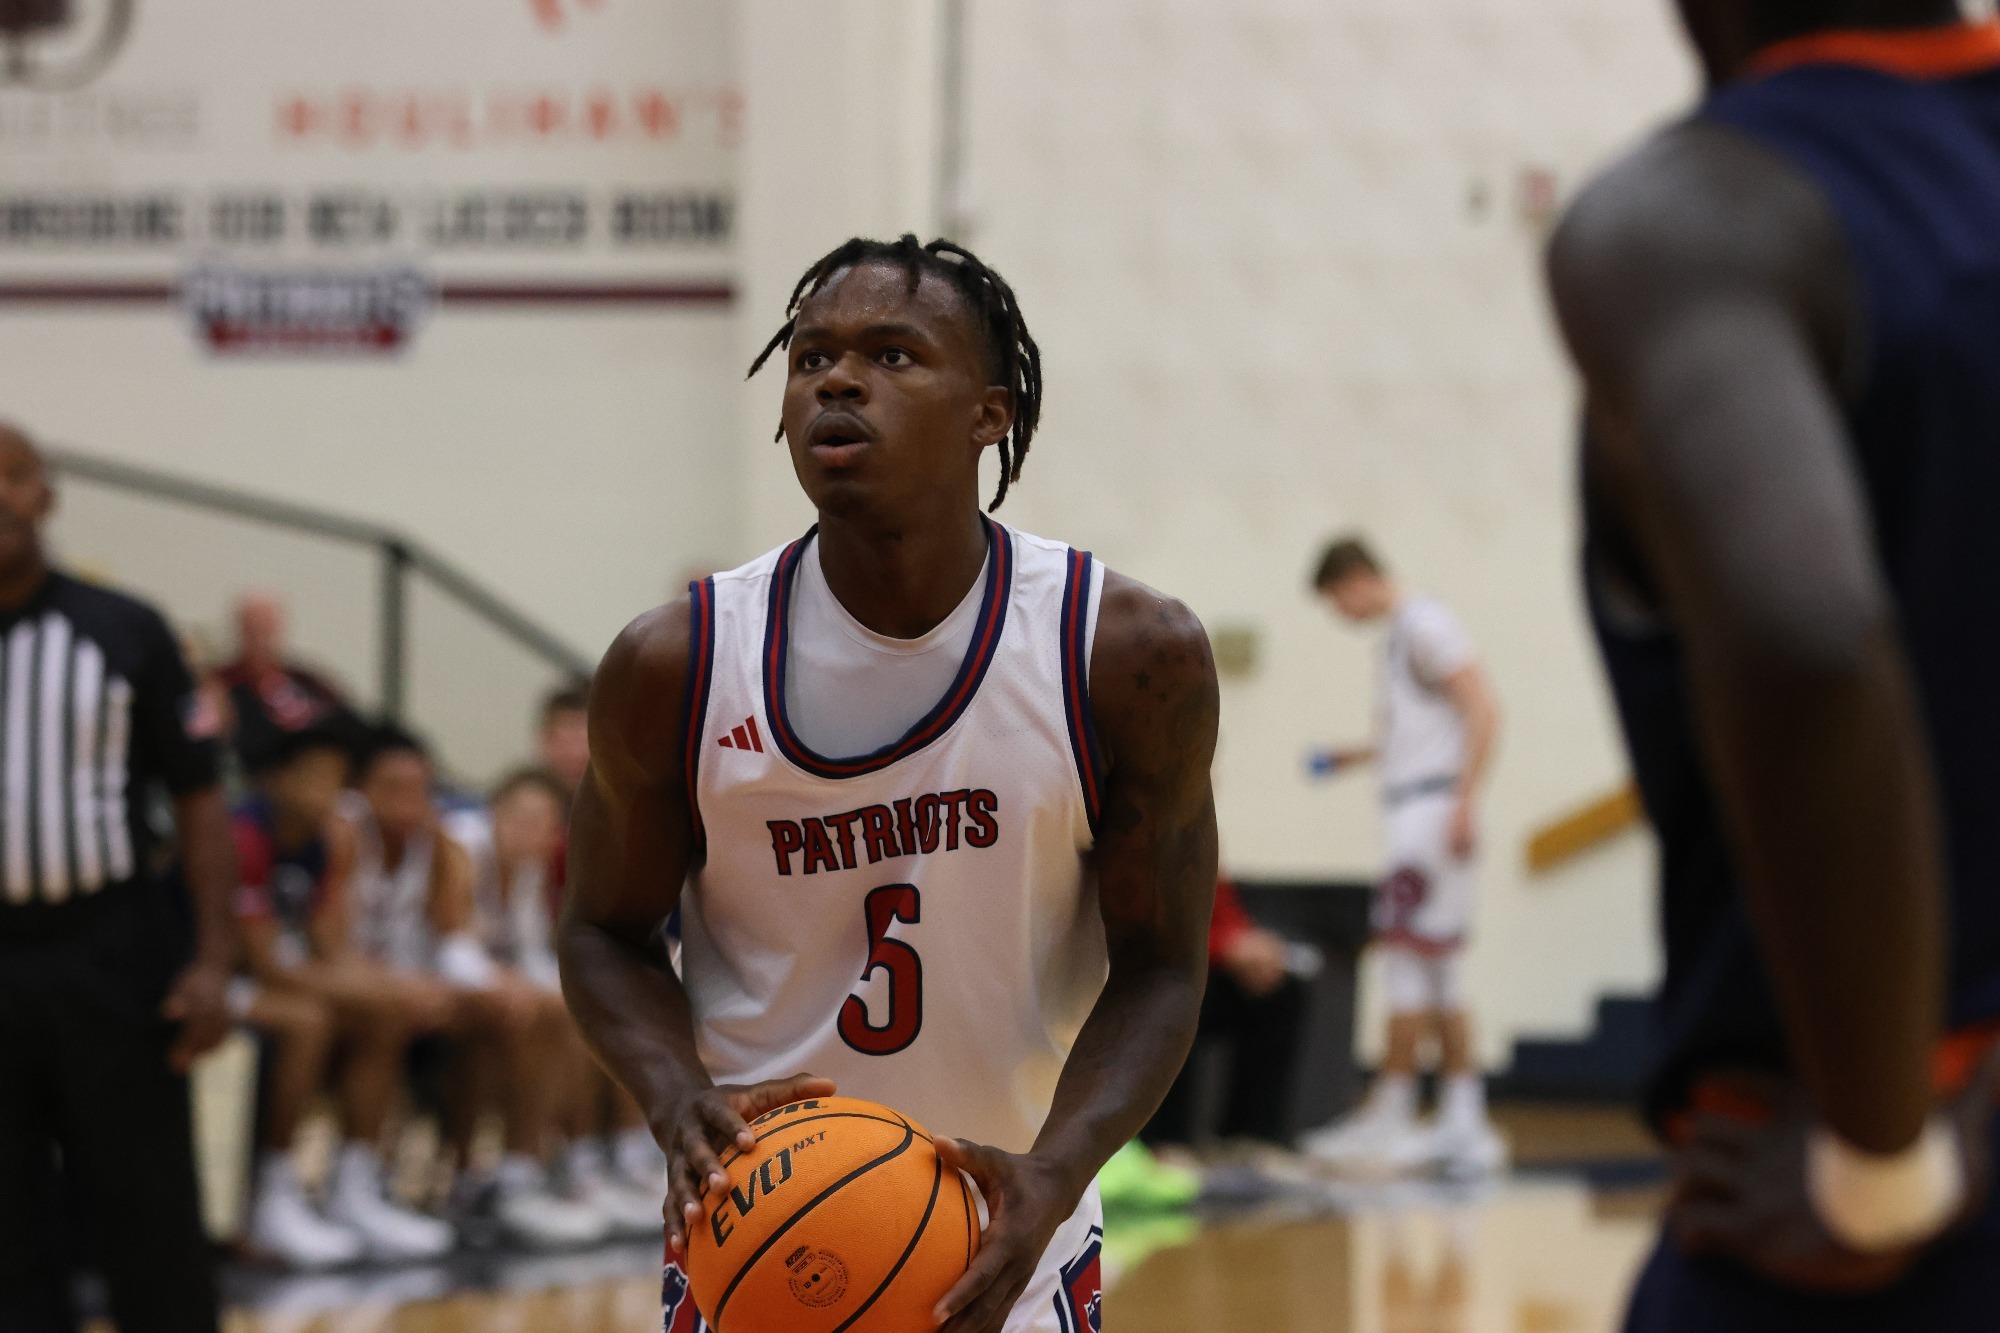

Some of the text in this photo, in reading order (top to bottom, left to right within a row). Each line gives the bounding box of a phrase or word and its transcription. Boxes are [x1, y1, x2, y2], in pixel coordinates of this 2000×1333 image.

[766, 788, 999, 876] PATRIOTS
[836, 883, 923, 1057] 5
[710, 1131, 827, 1248] EVO NXT
